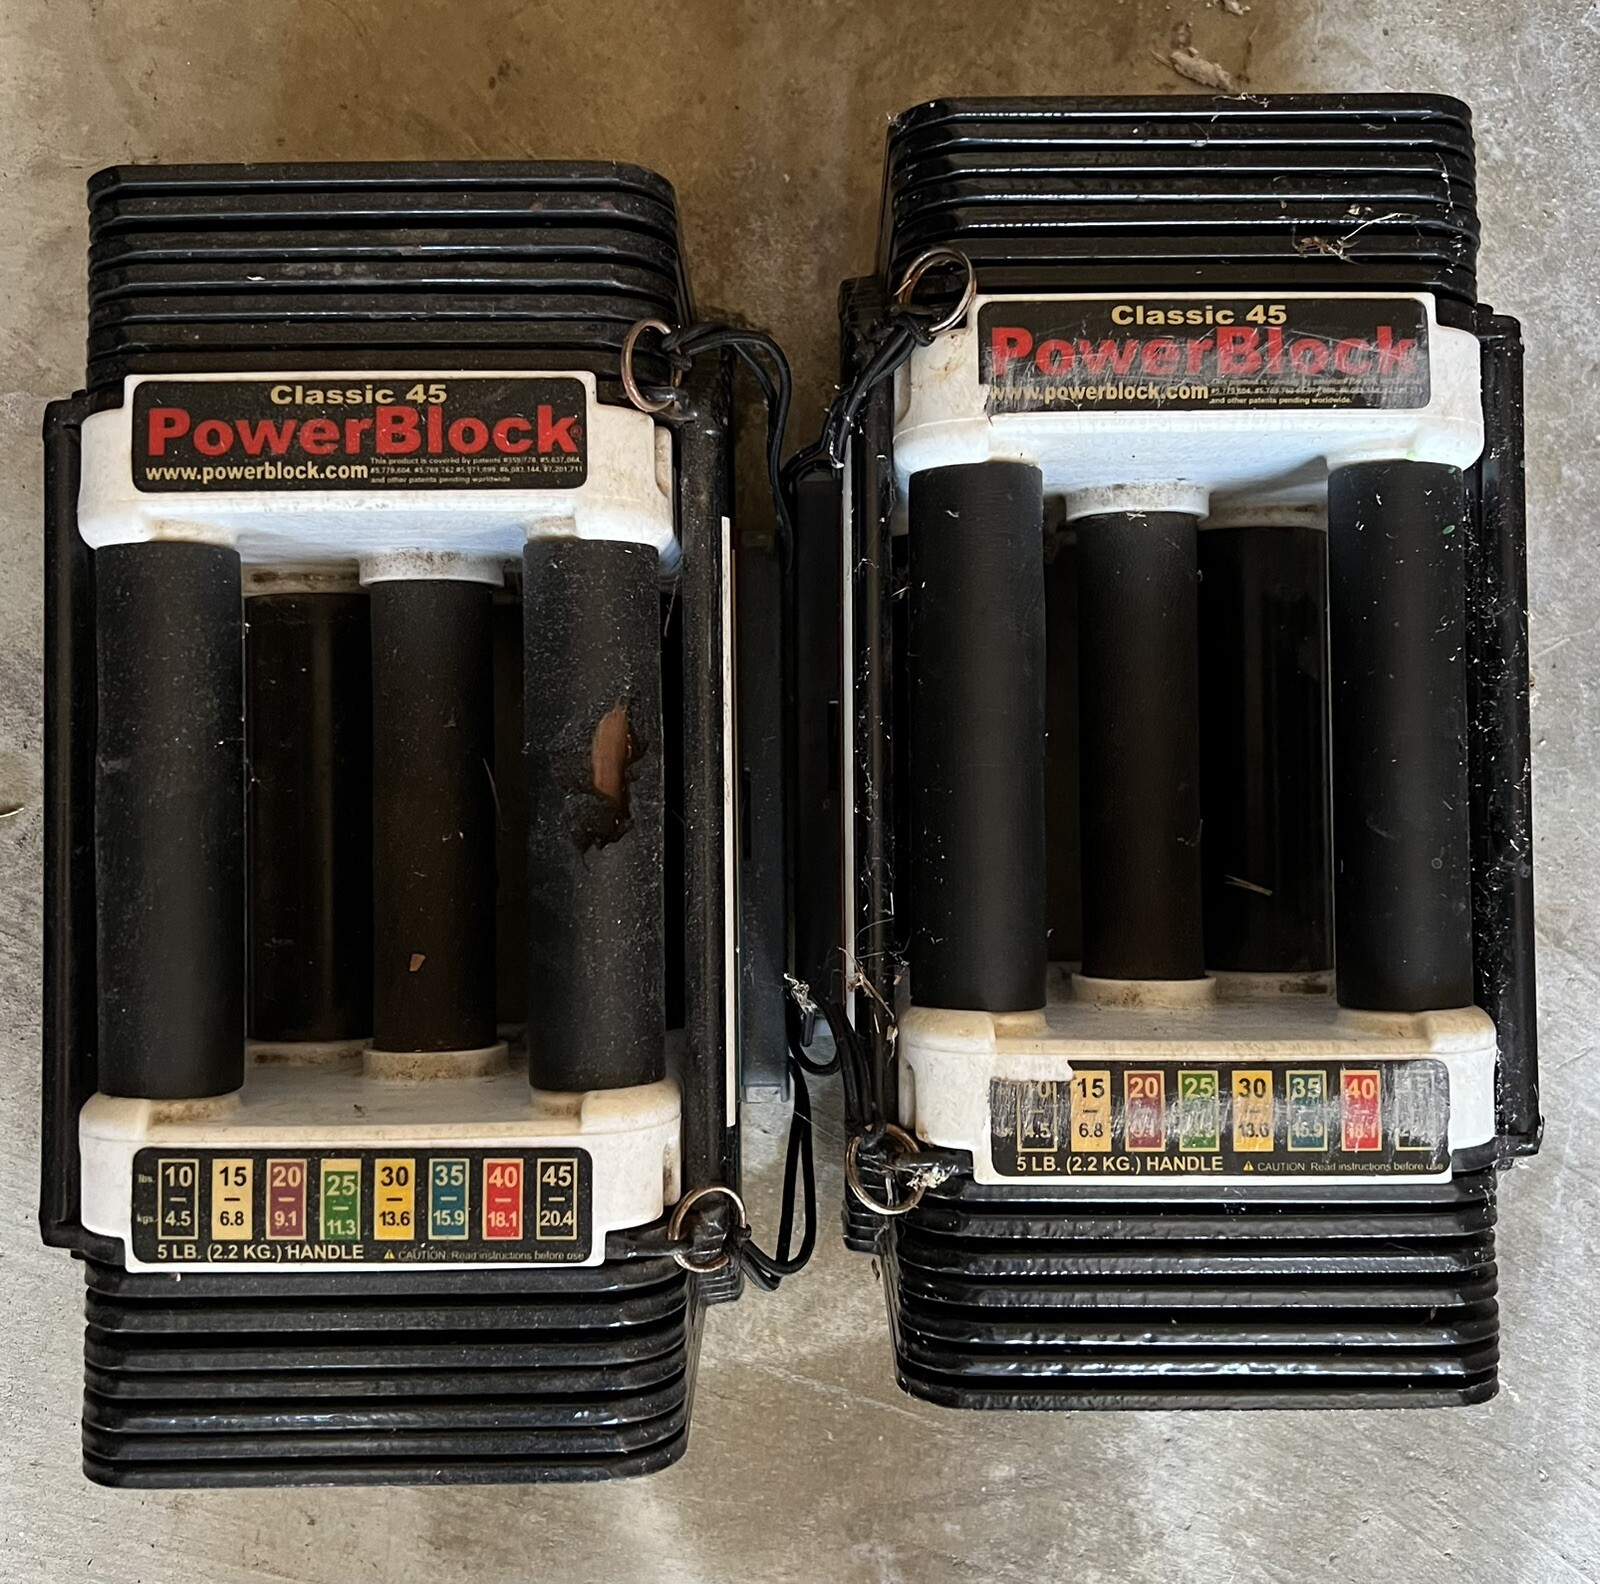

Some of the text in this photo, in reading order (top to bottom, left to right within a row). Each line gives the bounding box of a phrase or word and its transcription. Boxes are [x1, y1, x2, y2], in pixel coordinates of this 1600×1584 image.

[1111, 304, 1287, 326] Classic 45
[991, 325, 1417, 377] PowerBlock
[270, 384, 447, 405] Classic 45
[990, 381, 1209, 405] www.powerblock.com
[148, 404, 579, 456] PowerBlock
[146, 461, 368, 484] www.powerblock.com
[1077, 1078, 1105, 1099] 15
[1129, 1077, 1159, 1099] 20
[1184, 1077, 1214, 1099] 25
[1238, 1078, 1266, 1098] 30
[1292, 1078, 1321, 1099] 35
[1347, 1078, 1375, 1100] 40
[1078, 1122, 1104, 1138] 6.8
[1016, 1157, 1224, 1174] 5 LB. (2.2 KG.) HANDLE
[1257, 1163, 1305, 1172] CAUTION
[1310, 1163, 1336, 1171] Read
[1338, 1162, 1391, 1171] instructions
[1393, 1162, 1424, 1171] before
[164, 1166, 193, 1187] 10
[219, 1166, 247, 1187] 15
[272, 1166, 300, 1187] 20
[326, 1175, 356, 1196] 25
[380, 1166, 409, 1187] 30
[434, 1165, 464, 1187] 35
[488, 1166, 518, 1188] 40
[542, 1165, 572, 1187] 45
[165, 1210, 191, 1226] 4.5
[219, 1210, 244, 1226] 6.8
[274, 1210, 297, 1226] 9.1
[327, 1219, 356, 1235] 11.3
[379, 1211, 411, 1226] 13.6
[433, 1210, 464, 1226] 15.9
[487, 1210, 518, 1227] 18.1
[540, 1210, 573, 1226] 20.4
[157, 1244, 364, 1262] 5 LB. (2.2 KG.) HANDLE
[398, 1250, 446, 1260] CAUTION
[451, 1251, 477, 1260] Read
[479, 1250, 532, 1260] instructions
[534, 1250, 565, 1259] before
